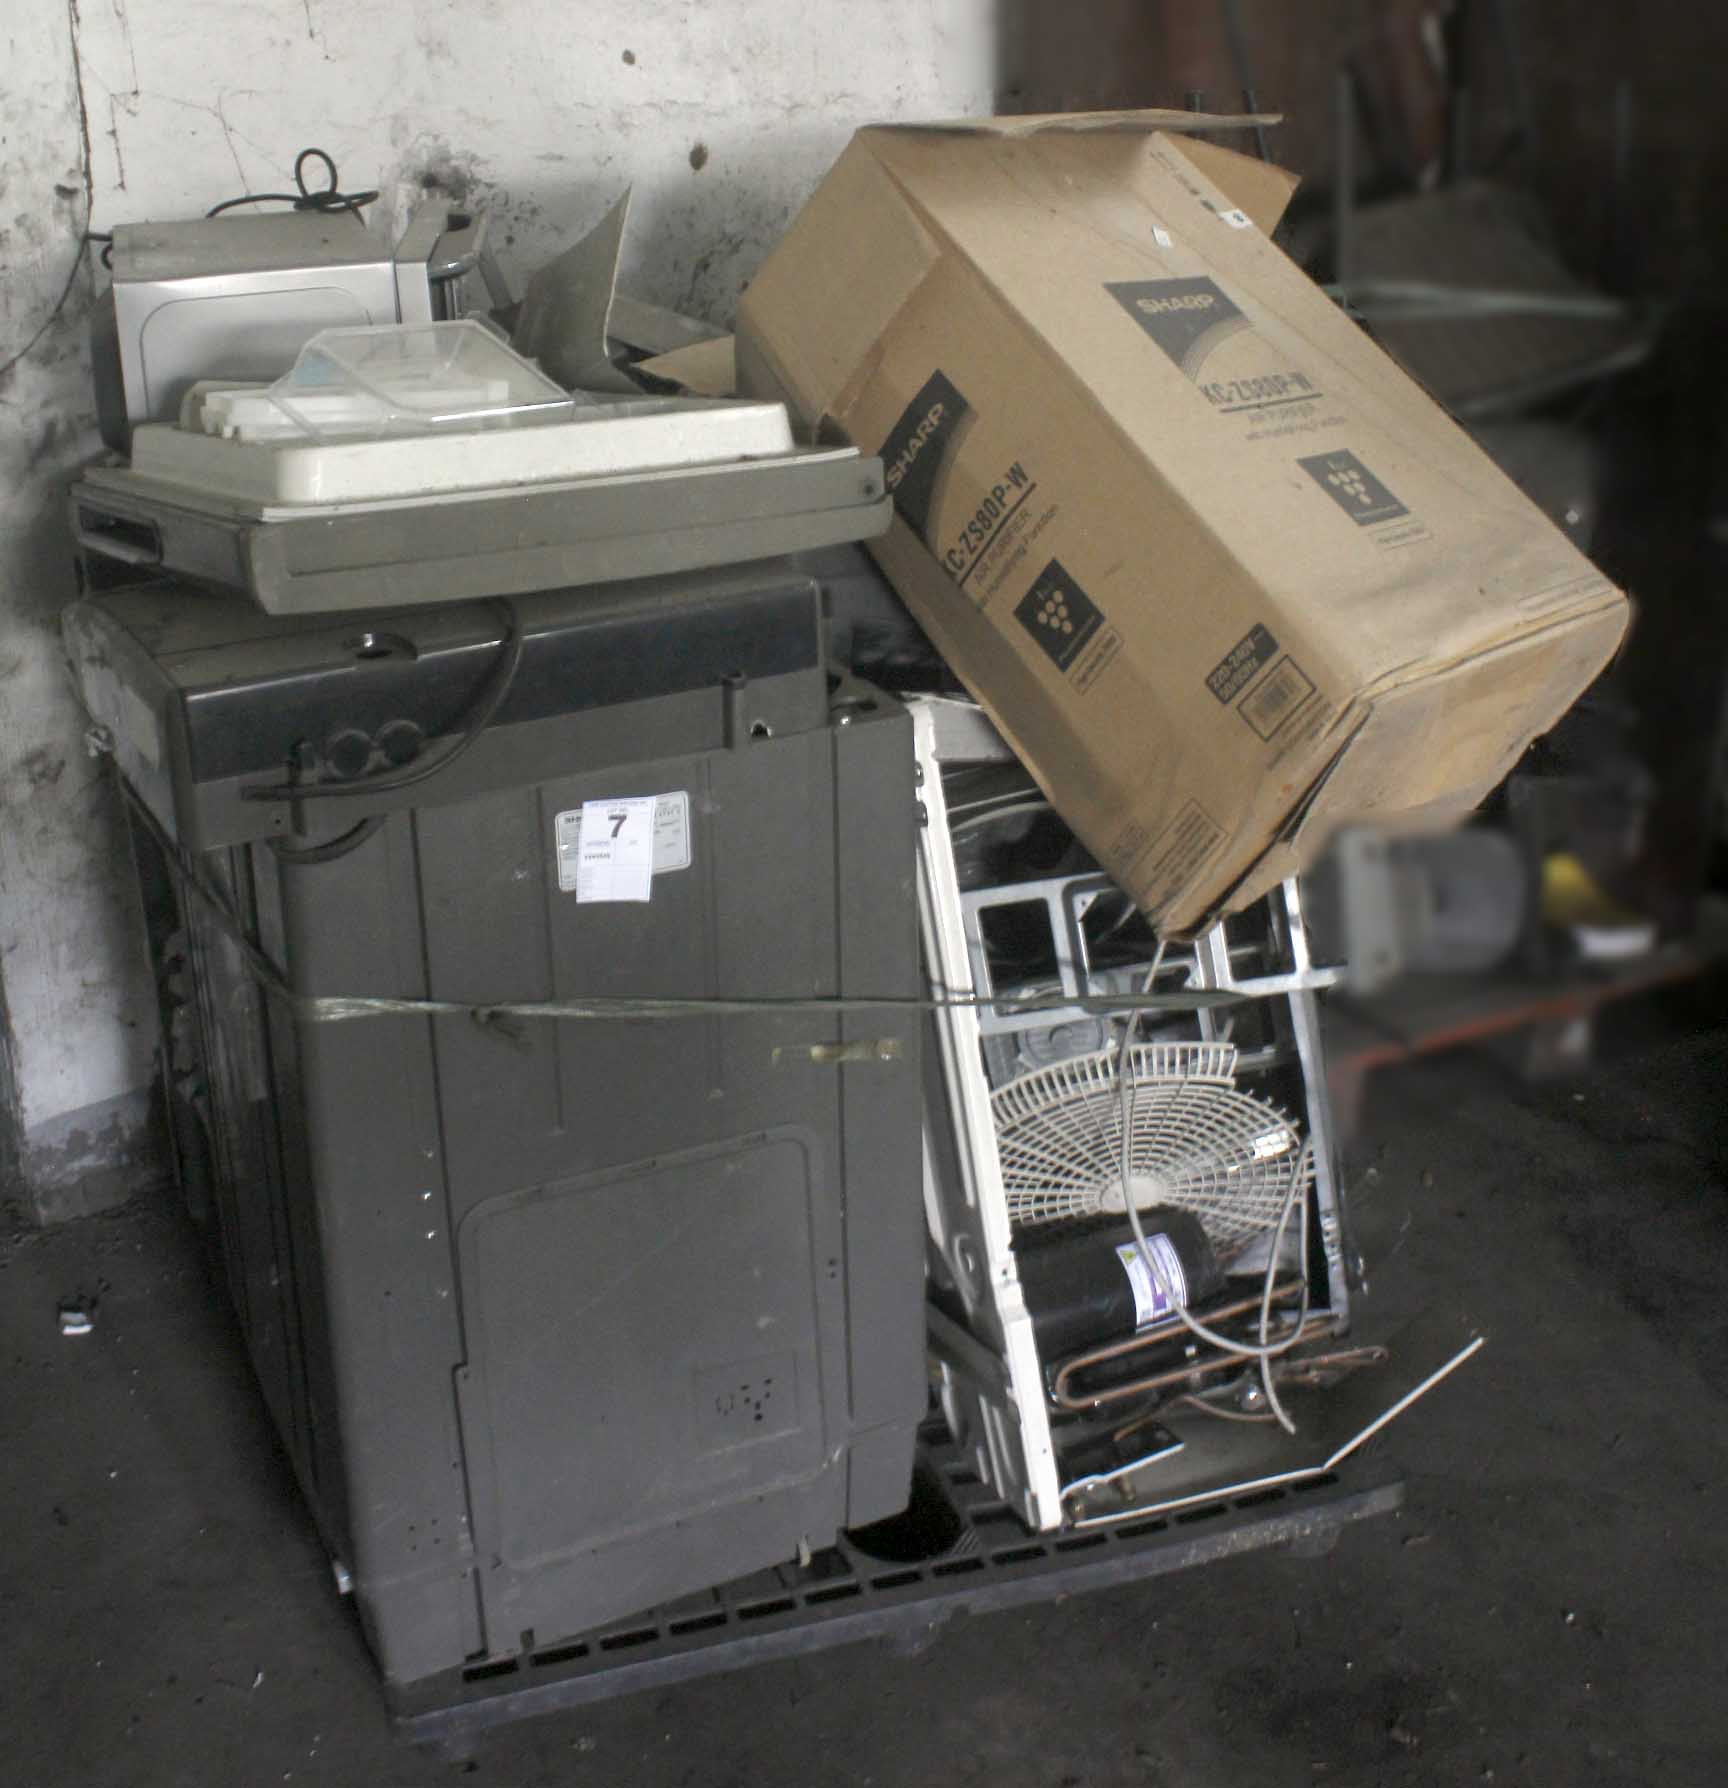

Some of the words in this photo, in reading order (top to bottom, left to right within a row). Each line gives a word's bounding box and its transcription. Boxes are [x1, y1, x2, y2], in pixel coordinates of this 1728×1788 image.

[1136, 293, 1215, 315] SHARP
[886, 402, 946, 488] SHARP
[608, 814, 628, 838] 7
